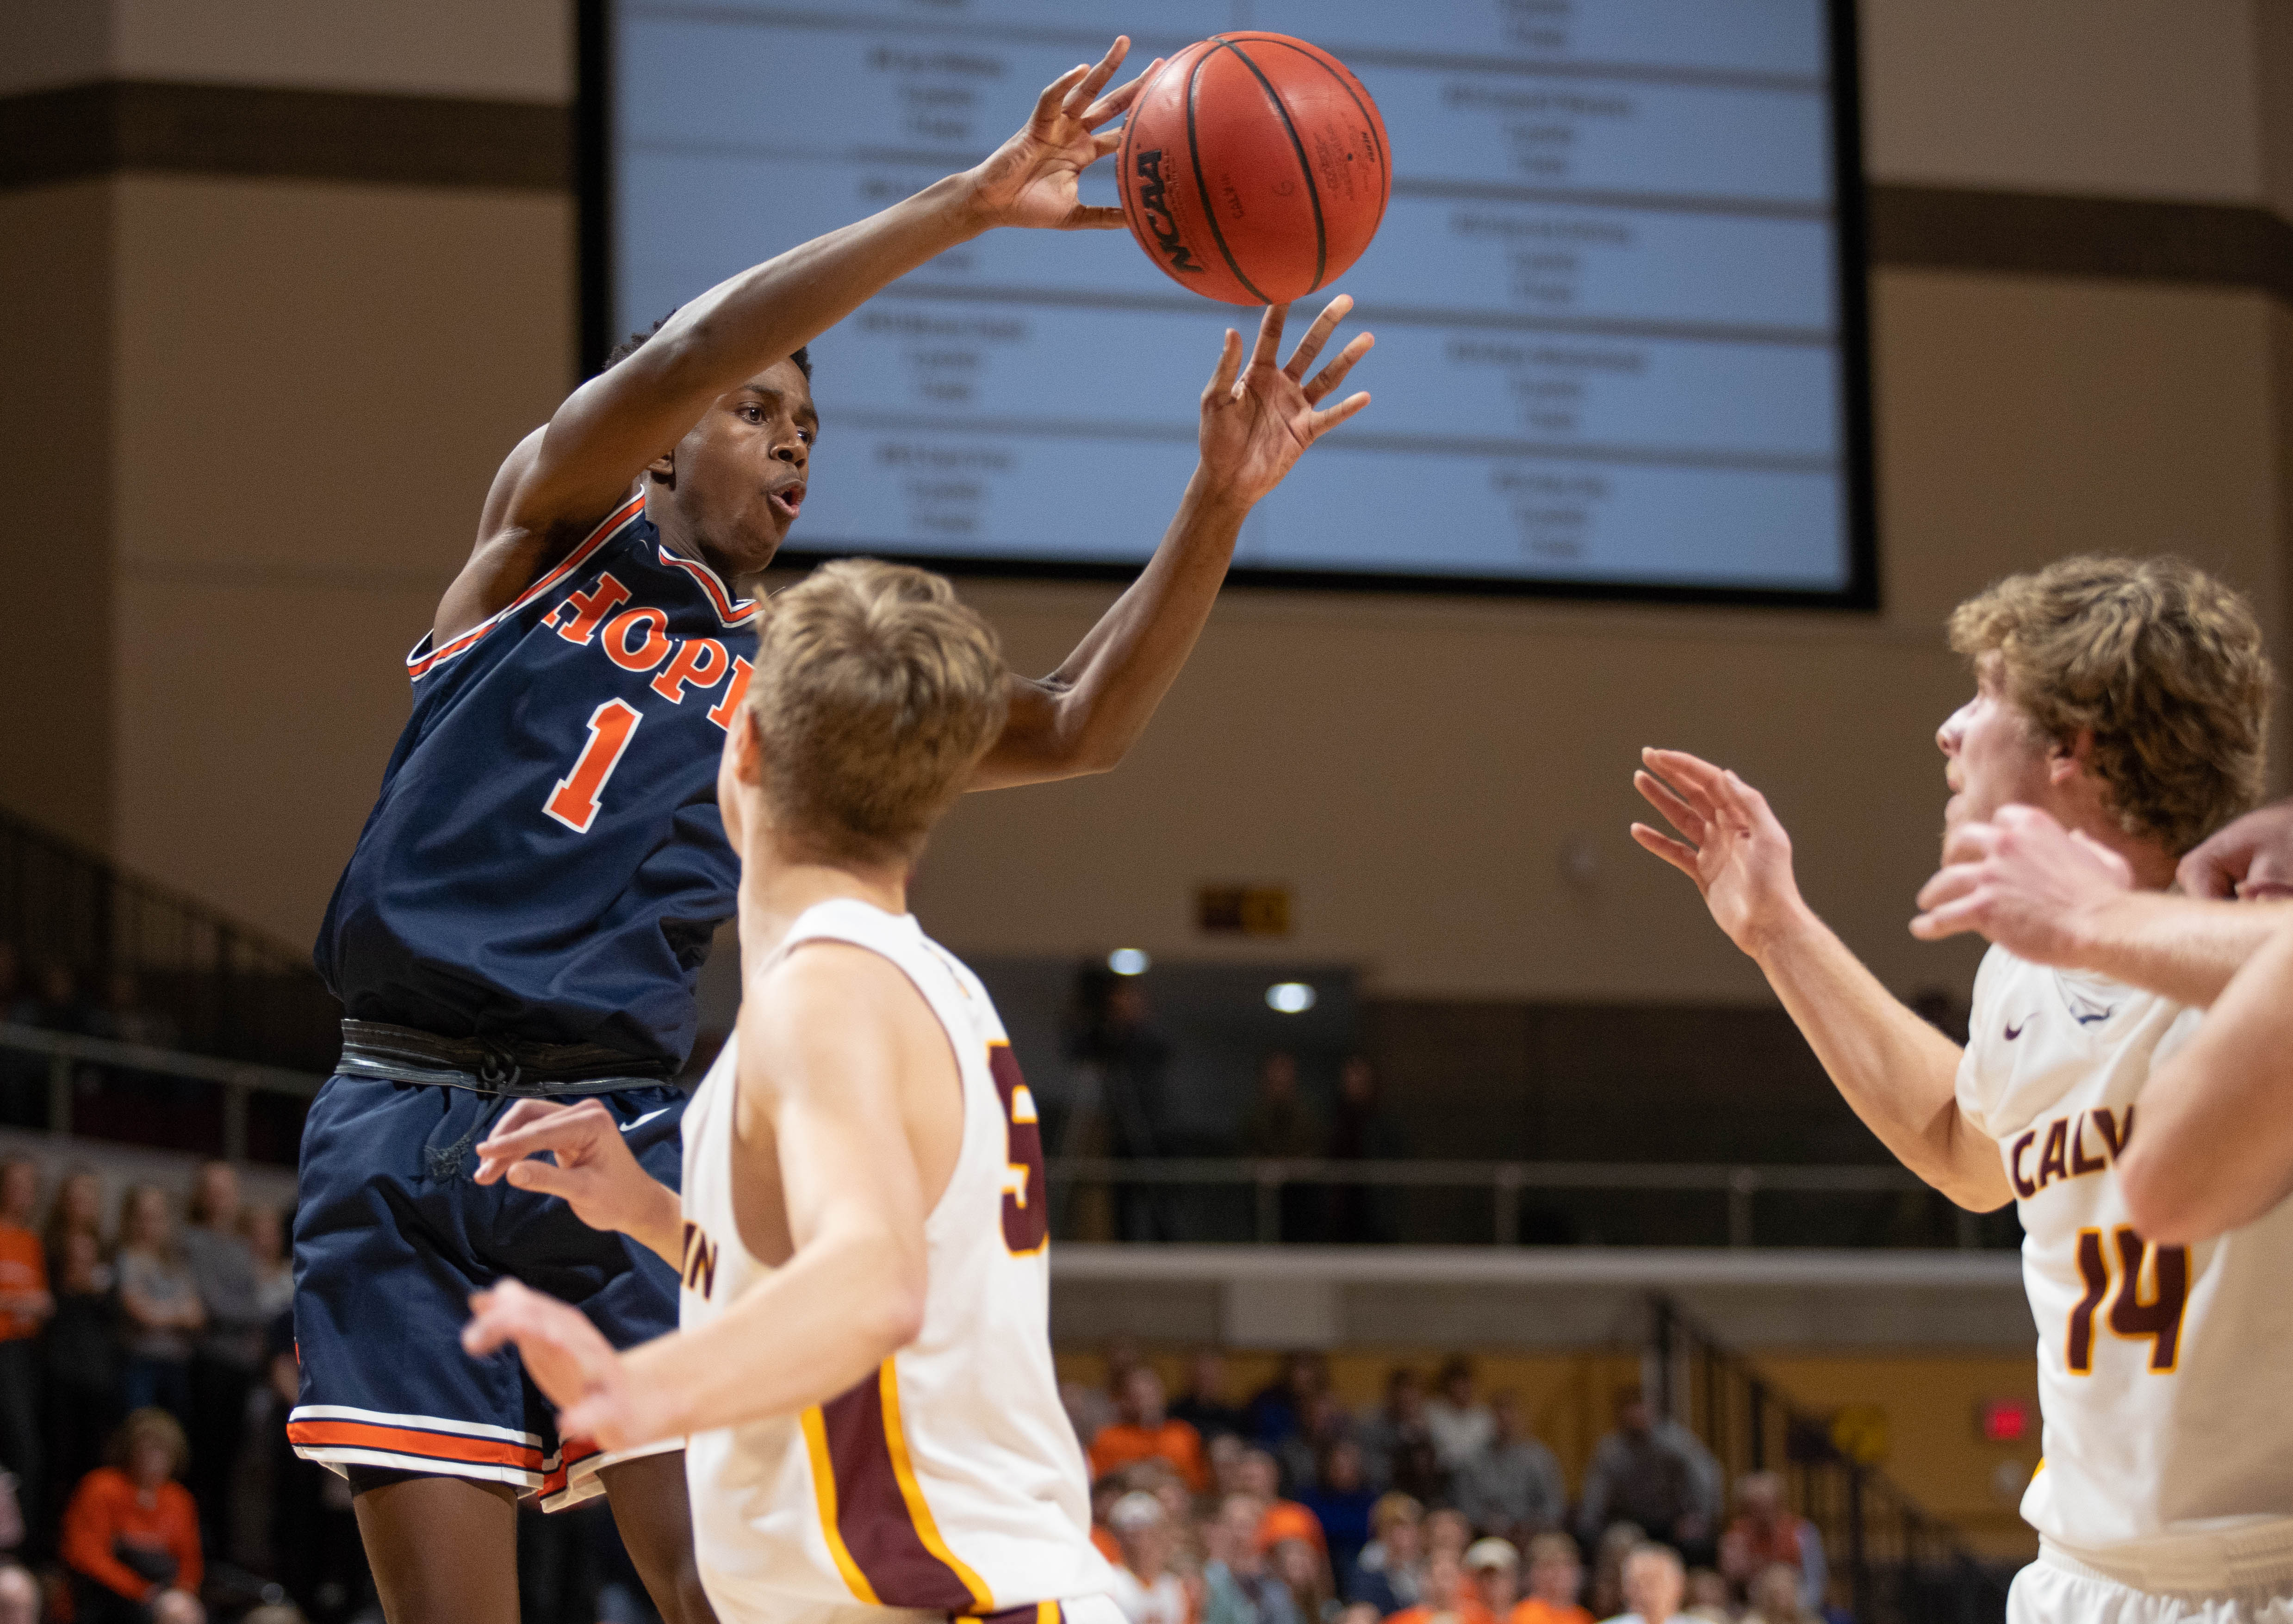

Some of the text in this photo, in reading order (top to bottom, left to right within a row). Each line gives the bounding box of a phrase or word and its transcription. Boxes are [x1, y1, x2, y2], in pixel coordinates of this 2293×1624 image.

[1137, 149, 1203, 273] NCAA
[542, 697, 643, 833] 1
[985, 1039, 1050, 1258] 5
[2065, 1223, 2193, 1376] 14
